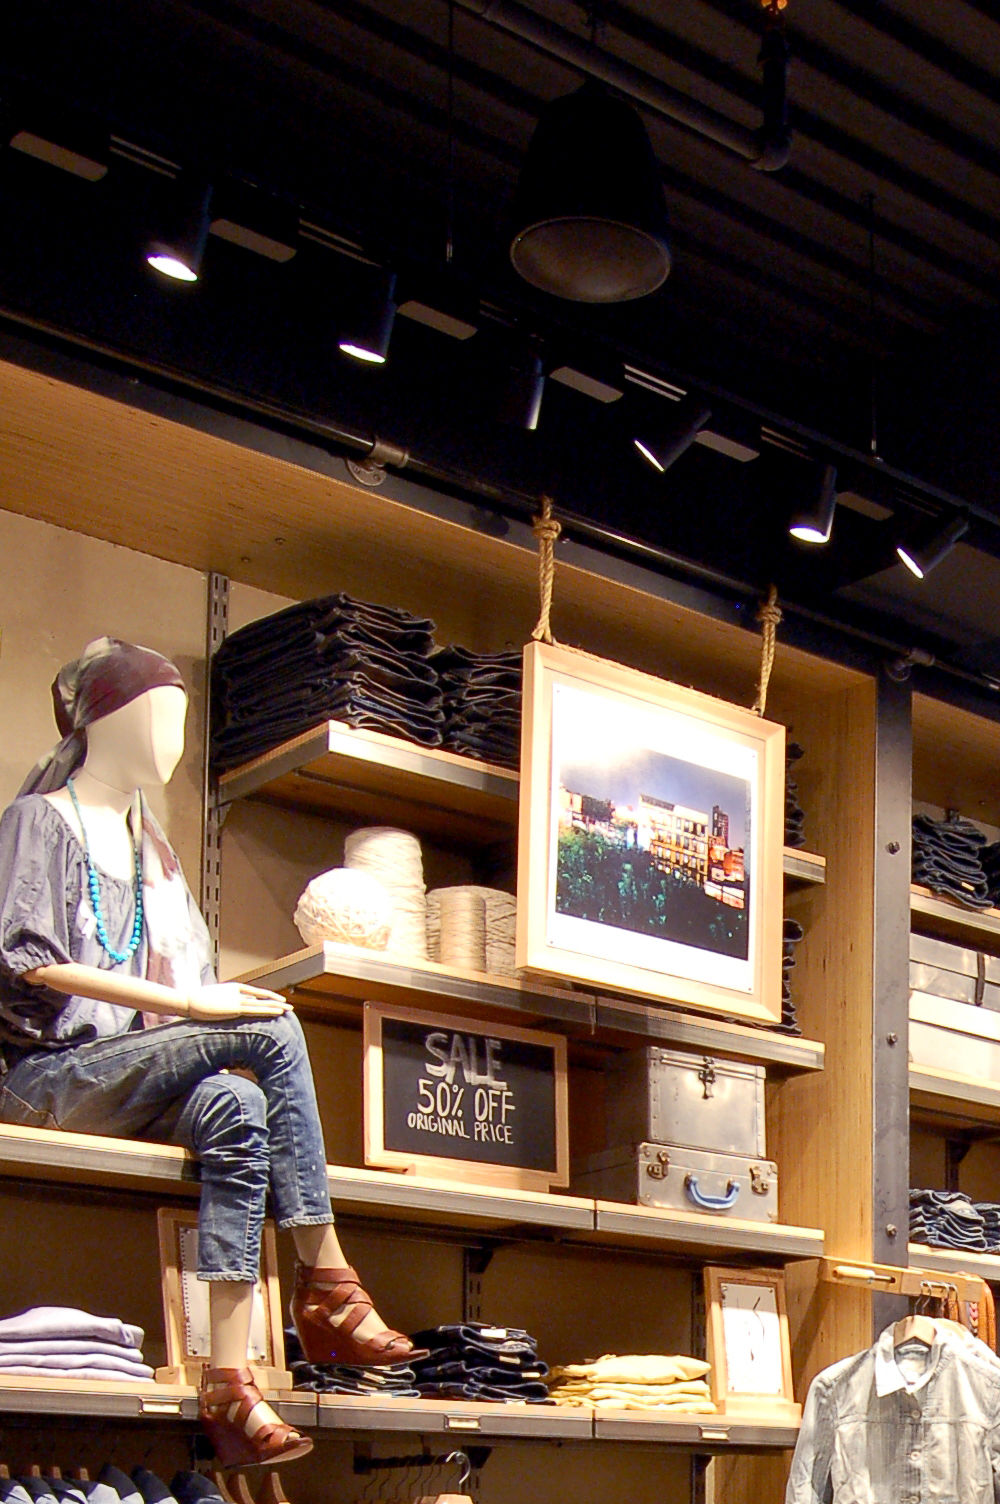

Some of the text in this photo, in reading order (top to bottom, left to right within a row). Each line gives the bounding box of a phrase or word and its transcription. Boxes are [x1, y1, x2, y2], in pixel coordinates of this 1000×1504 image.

[424, 1032, 508, 1090] SALE
[417, 1078, 516, 1125] 50% OFF
[407, 1112, 514, 1144] ORIGINAL PRICE
